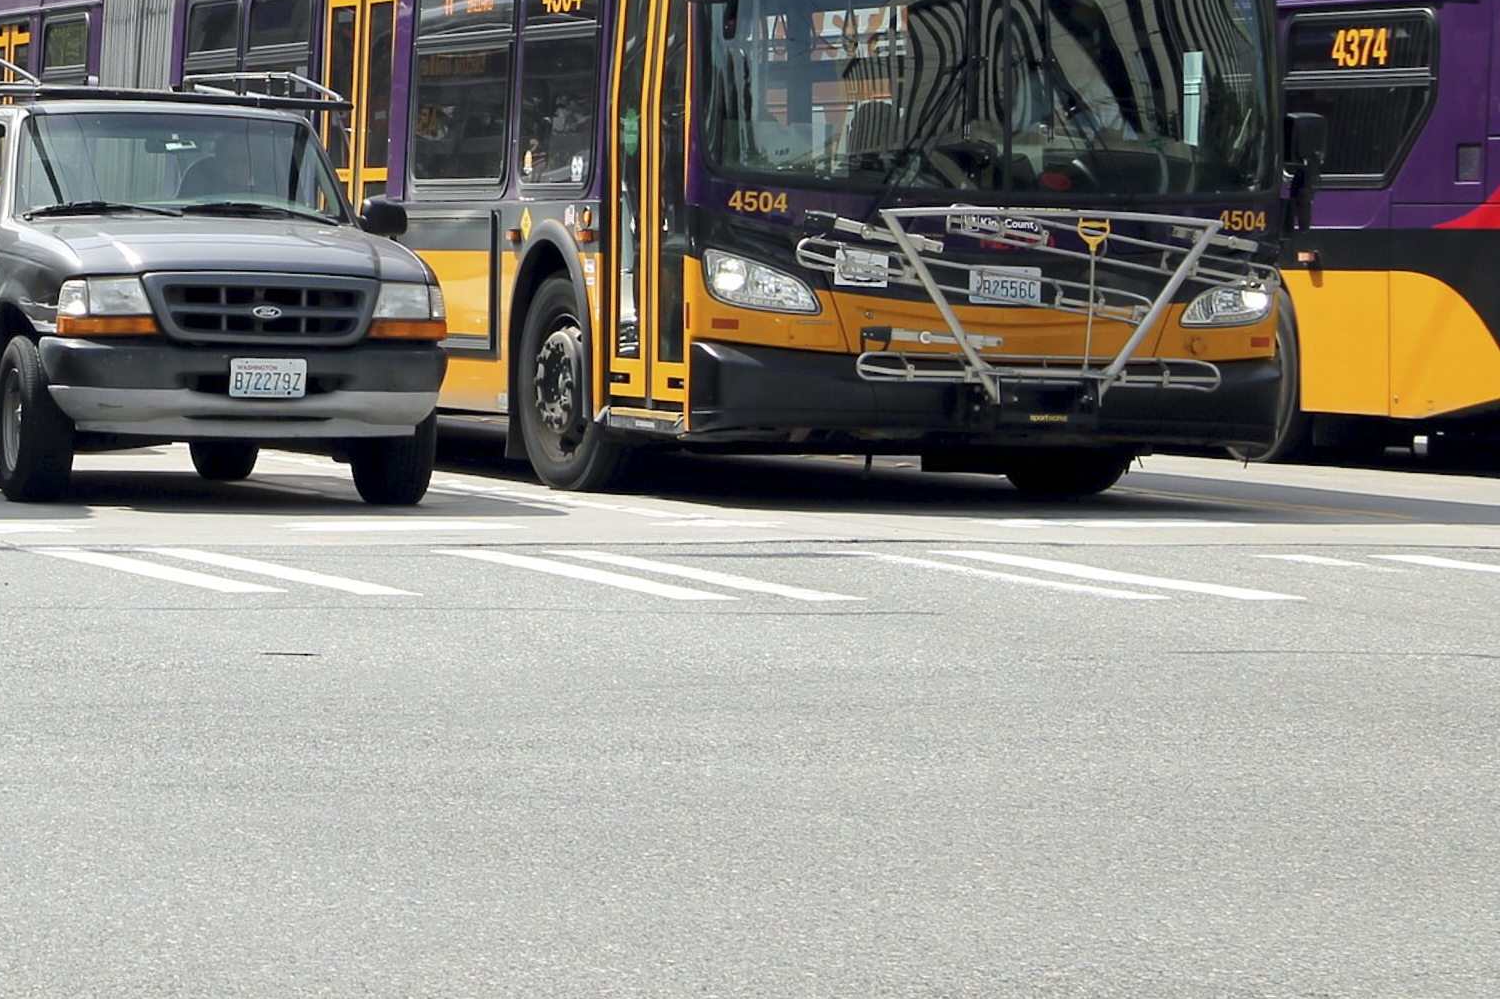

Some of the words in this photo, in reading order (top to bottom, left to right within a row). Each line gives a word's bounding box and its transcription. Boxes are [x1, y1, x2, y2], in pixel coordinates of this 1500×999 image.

[1331, 27, 1388, 67] 4374
[728, 190, 788, 213] 4504
[1220, 210, 1266, 231] 4504
[234, 371, 301, 391] B72279Z
